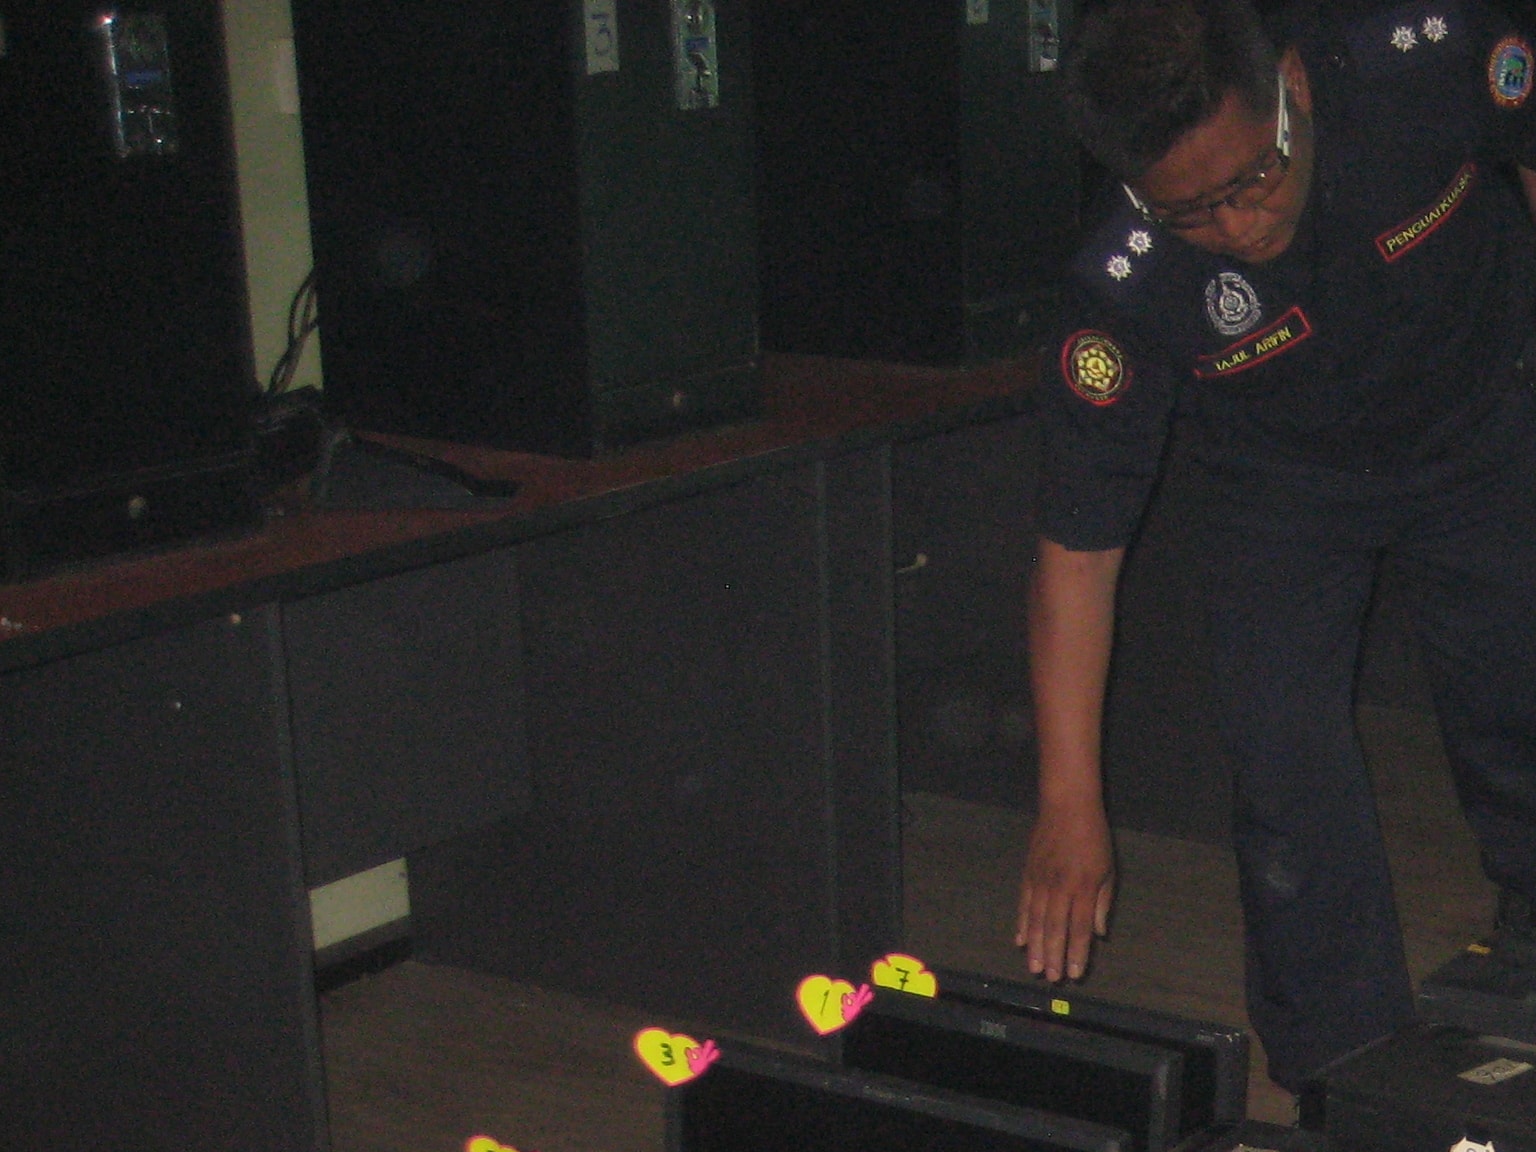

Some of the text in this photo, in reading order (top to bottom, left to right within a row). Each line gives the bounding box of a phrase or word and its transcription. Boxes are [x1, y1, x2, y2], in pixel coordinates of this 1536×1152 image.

[1255, 326, 1292, 354] ARIFIN
[895, 967, 910, 990] 7
[819, 988, 830, 1017] 1
[659, 1042, 676, 1067] 3
